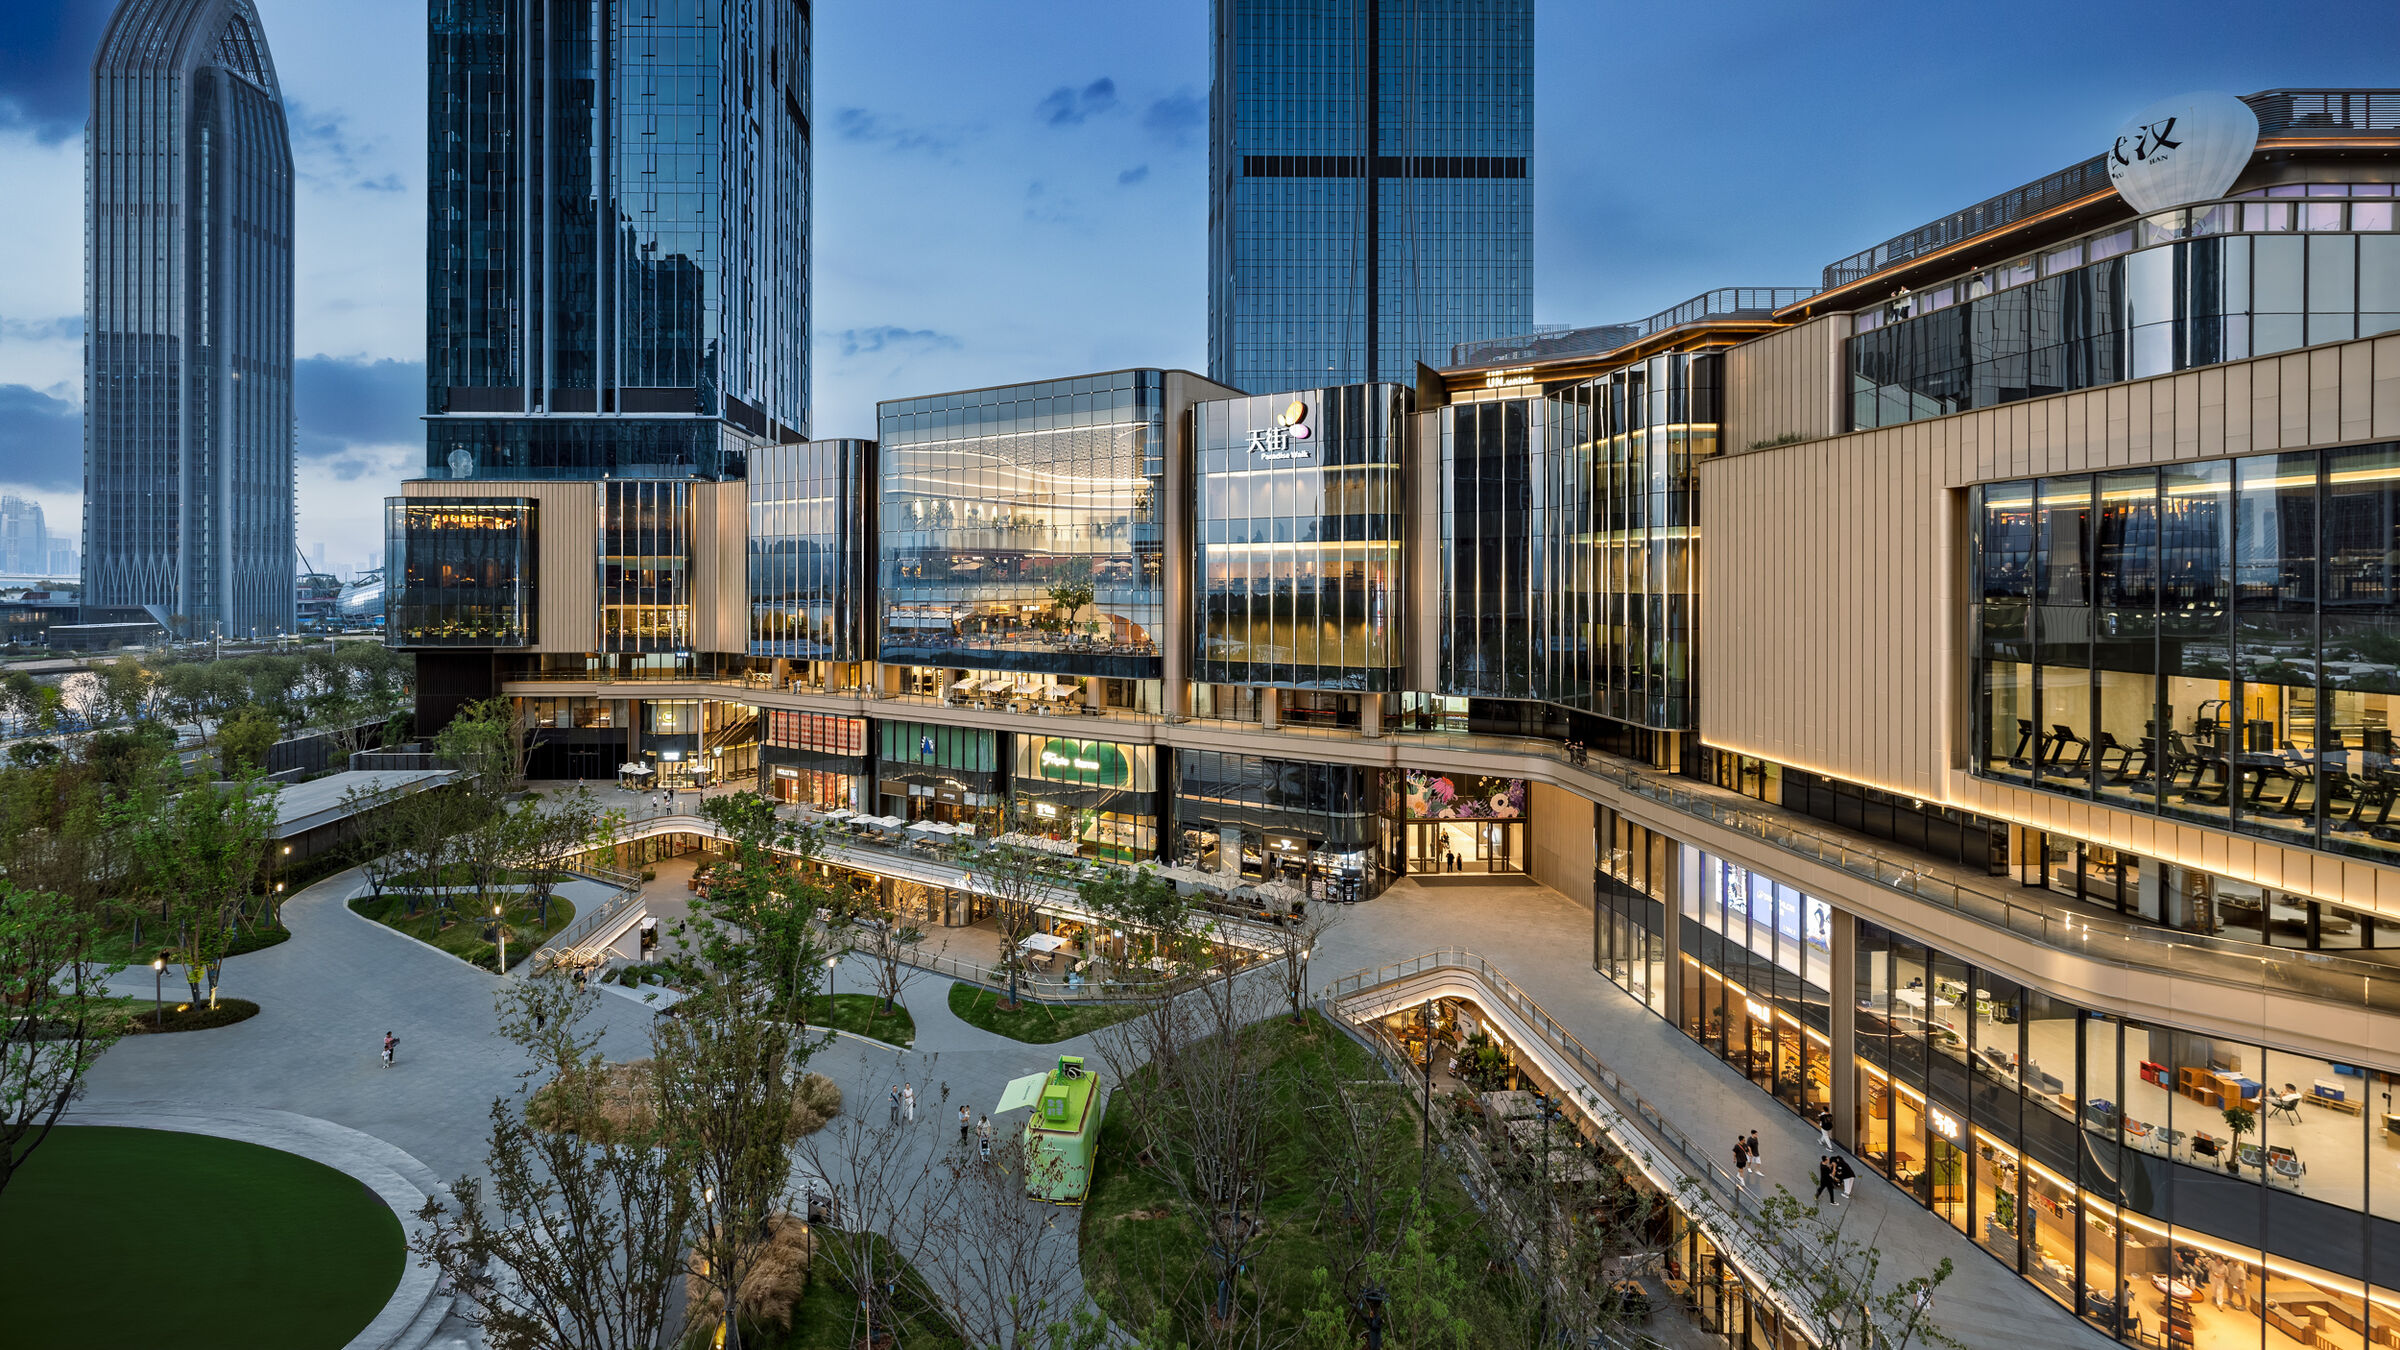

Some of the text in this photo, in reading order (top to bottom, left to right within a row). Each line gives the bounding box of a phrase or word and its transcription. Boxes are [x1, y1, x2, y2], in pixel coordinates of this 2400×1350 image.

[2149, 154, 2169, 166] HAN
[1245, 427, 1287, 453] 天街
[1261, 450, 1309, 461] Paradise Walk
